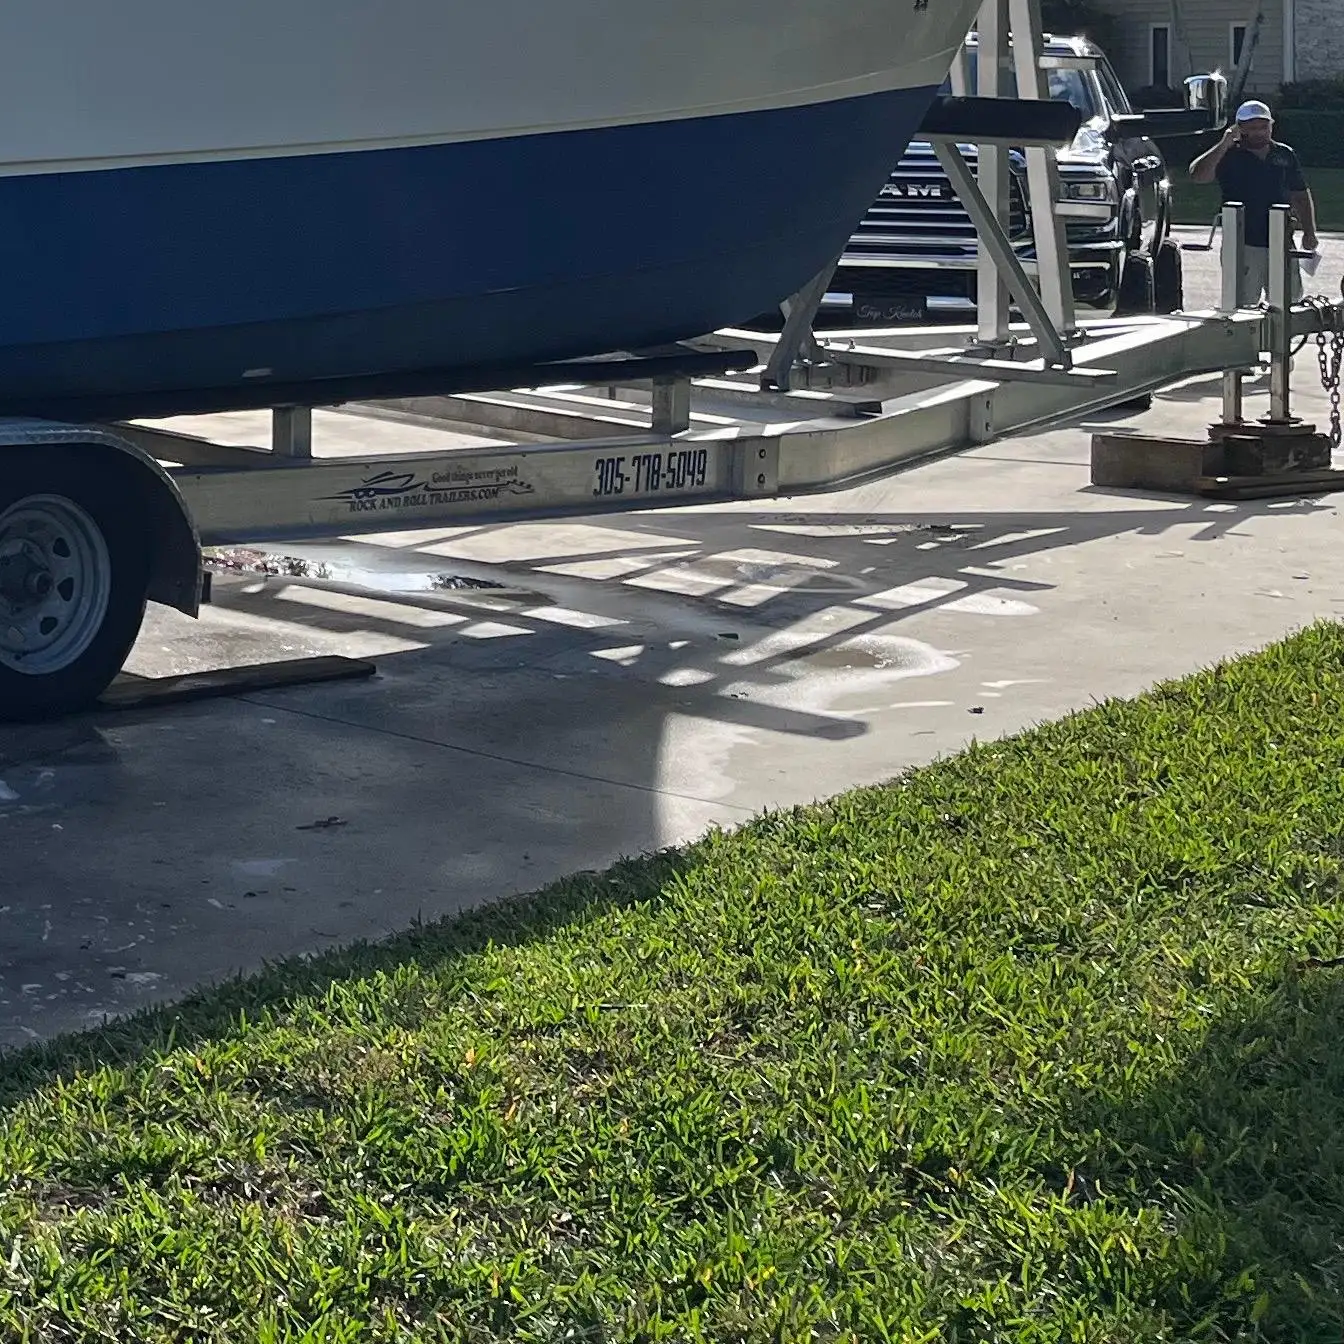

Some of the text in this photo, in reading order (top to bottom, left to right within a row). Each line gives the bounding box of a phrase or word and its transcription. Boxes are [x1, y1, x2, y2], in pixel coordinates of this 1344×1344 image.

[879, 183, 941, 196] AM
[593, 449, 707, 496] 305-778-5049
[350, 498, 377, 512] ROCK
[379, 496, 401, 509] AND
[403, 493, 428, 507] ROLL
